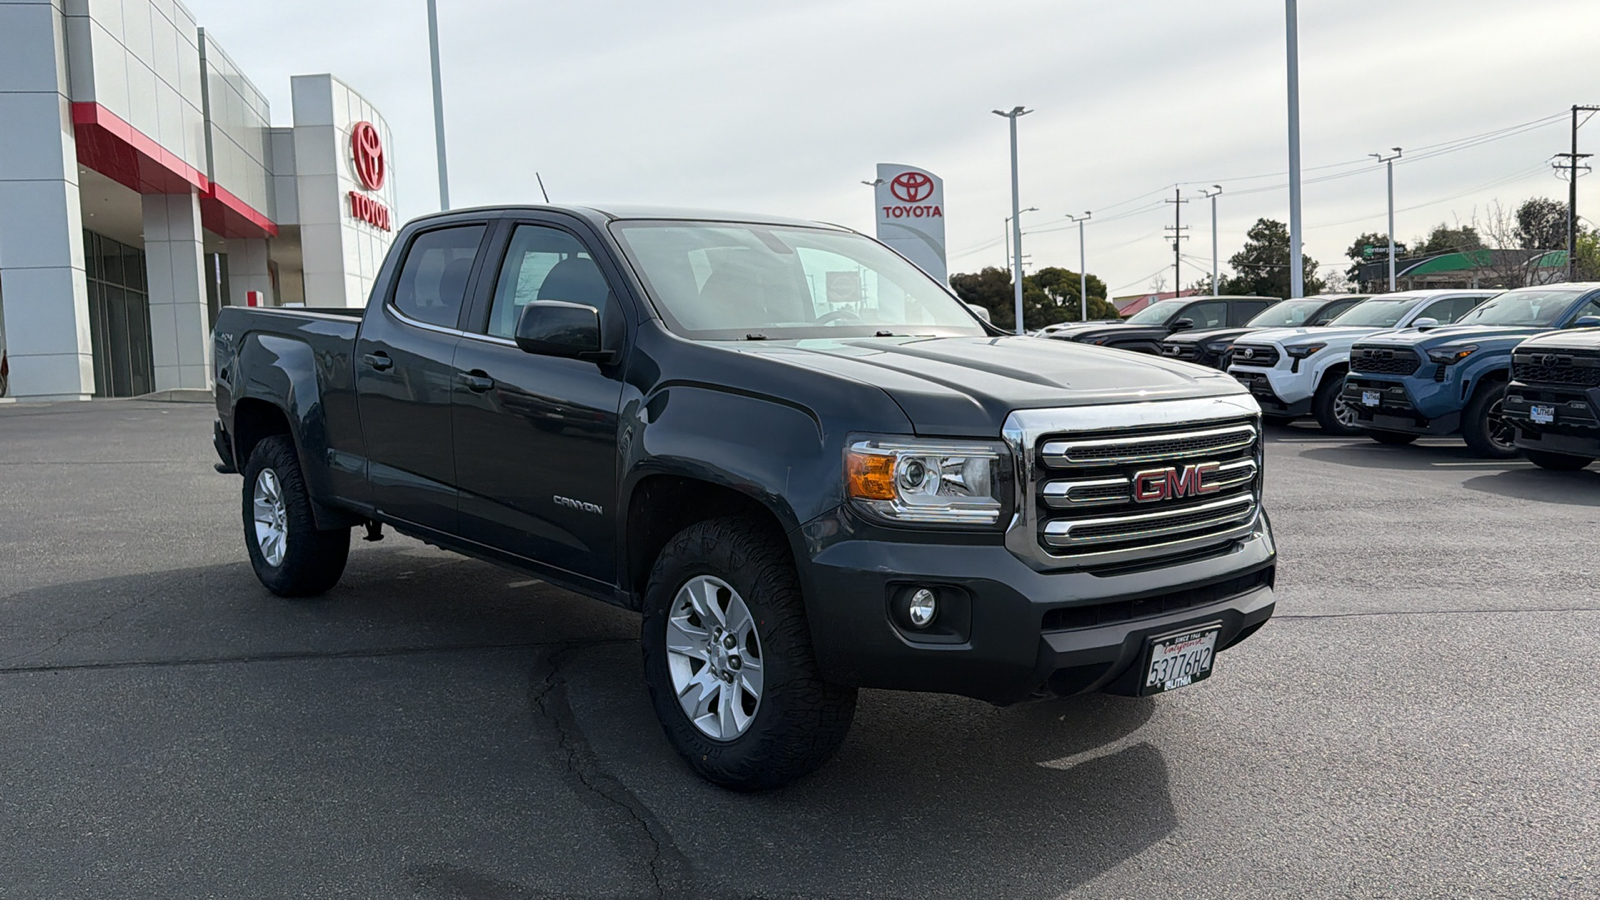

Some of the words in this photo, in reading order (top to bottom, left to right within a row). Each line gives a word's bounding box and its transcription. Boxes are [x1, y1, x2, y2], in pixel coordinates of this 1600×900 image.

[349, 191, 391, 232] TOYOTA
[883, 206, 942, 218] TOYOTA
[1366, 246, 1404, 254] enterpse
[1133, 462, 1220, 503] GMC
[553, 495, 603, 515] CANYON
[1164, 638, 1205, 655] California
[1149, 647, 1211, 685] 53776H2
